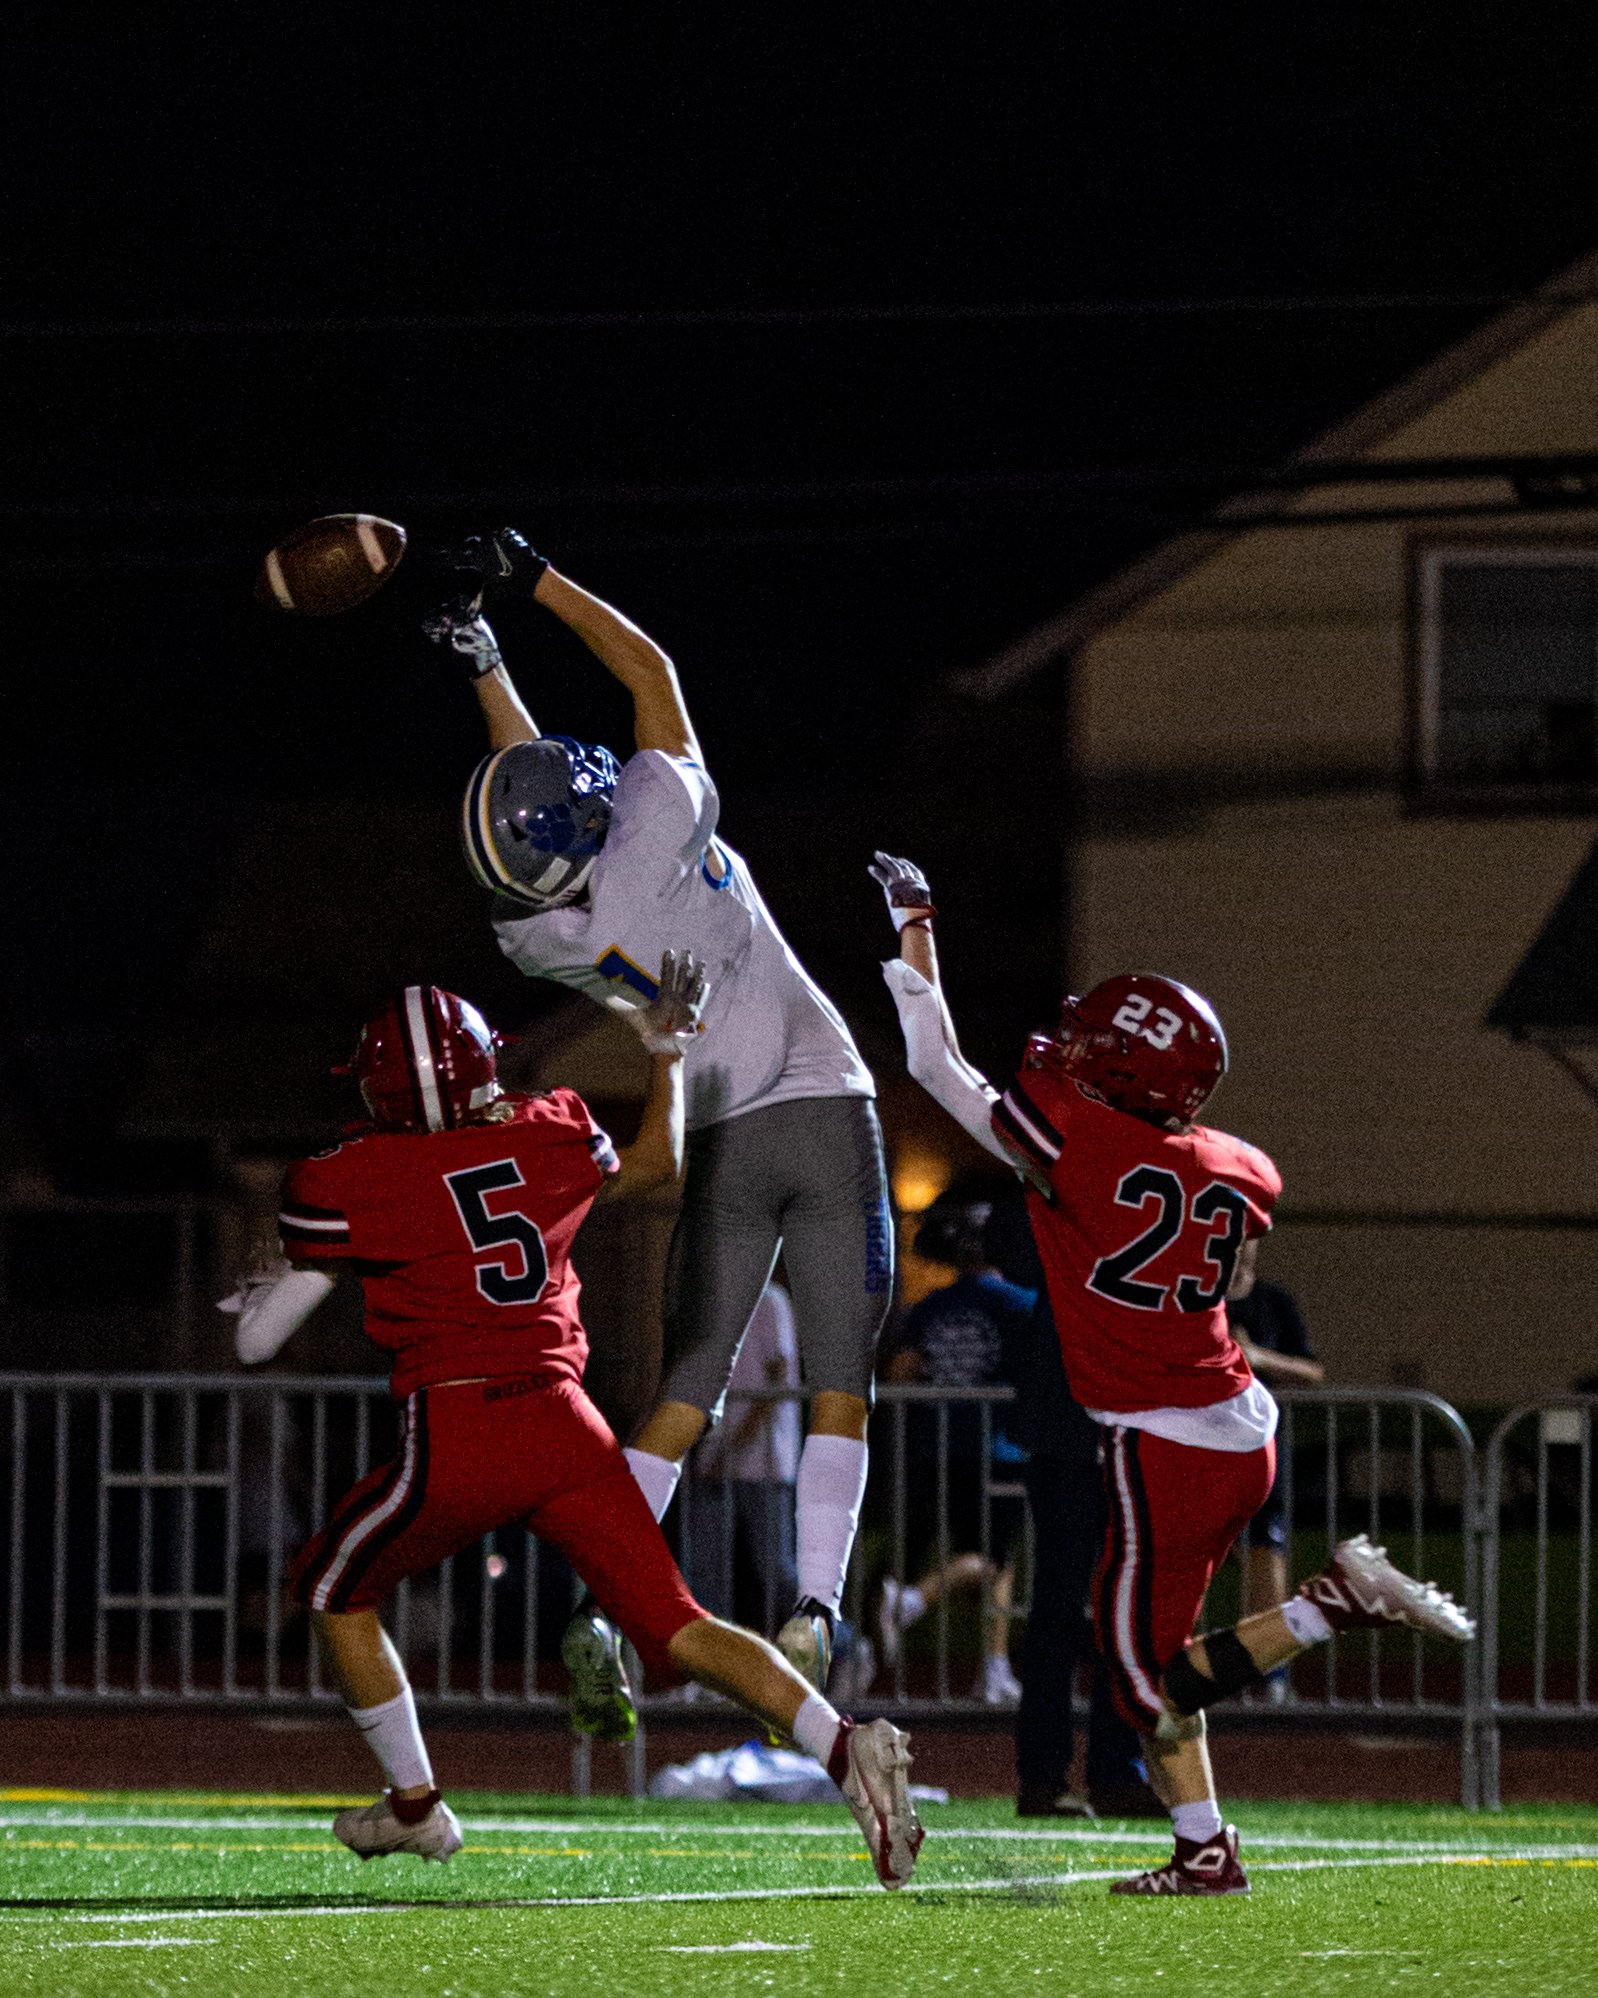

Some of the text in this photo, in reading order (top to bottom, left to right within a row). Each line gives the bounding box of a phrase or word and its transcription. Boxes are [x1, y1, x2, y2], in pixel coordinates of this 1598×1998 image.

[1111, 992, 1184, 1051] 23
[441, 1156, 549, 1307] 5
[1084, 1162, 1247, 1313] 23
